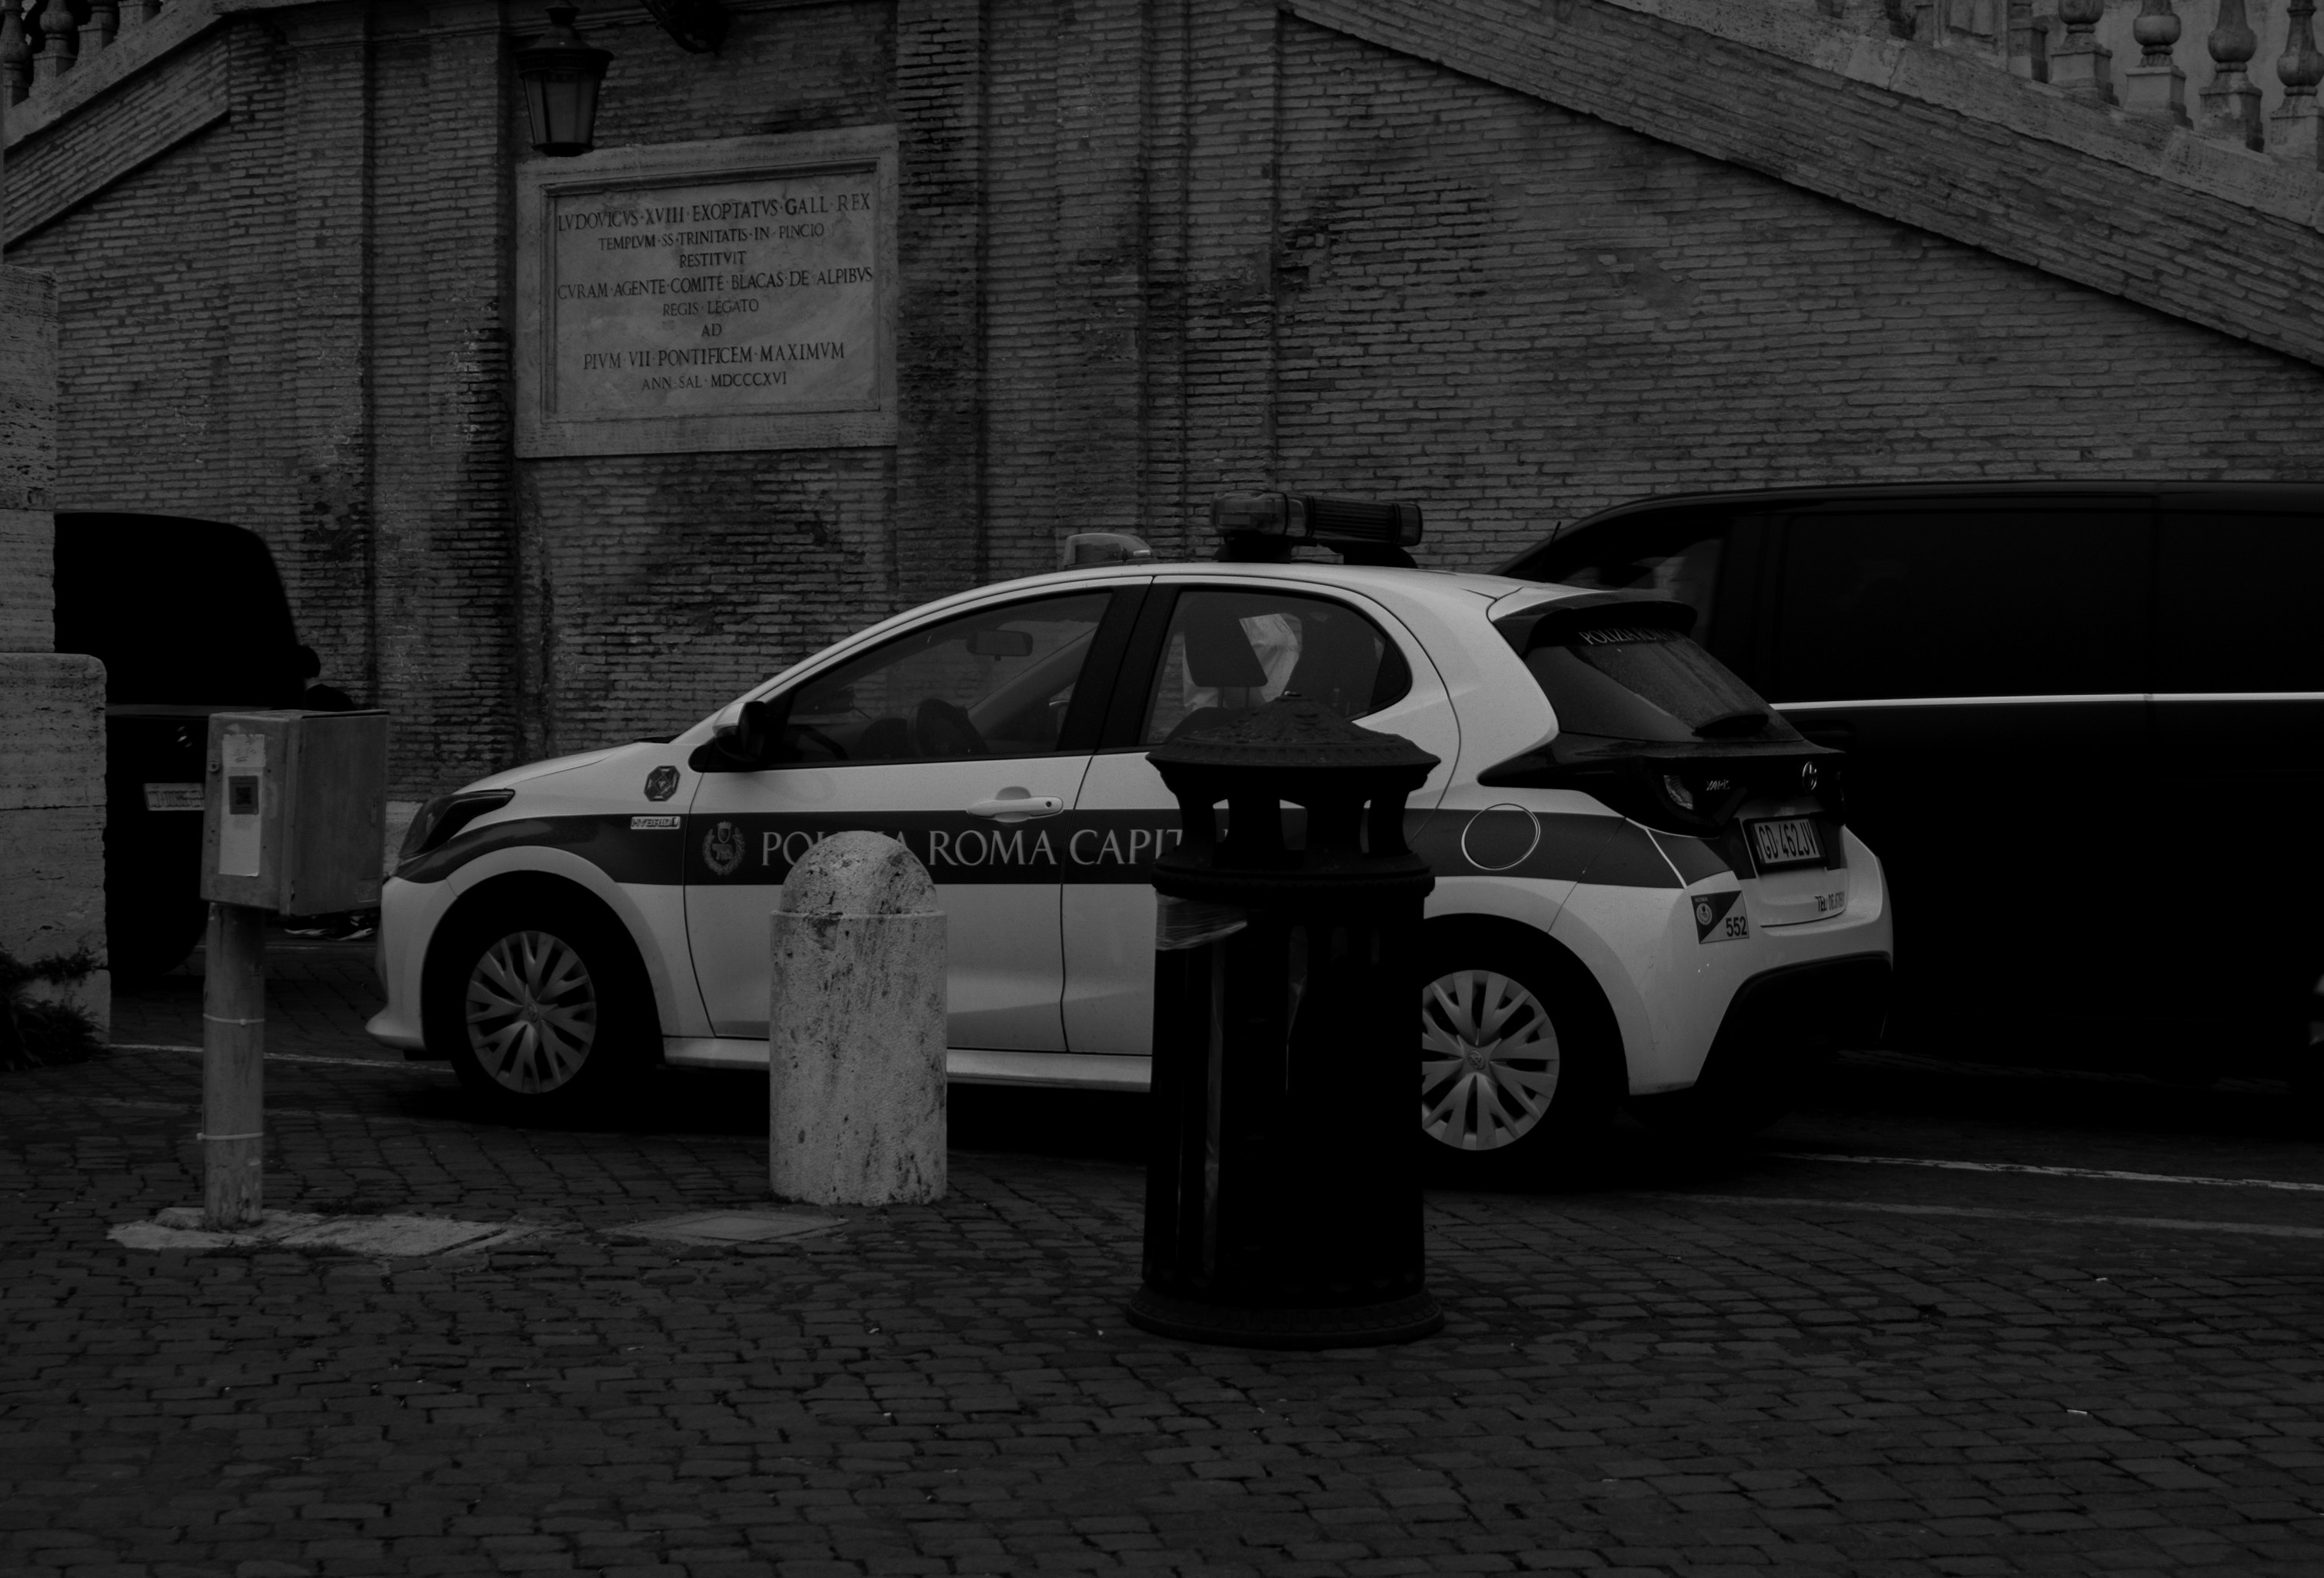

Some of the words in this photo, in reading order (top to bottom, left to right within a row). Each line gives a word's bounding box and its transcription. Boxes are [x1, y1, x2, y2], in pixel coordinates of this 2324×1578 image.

[558, 210, 639, 231] LVDOVICVS
[645, 207, 684, 225] XVIII
[692, 198, 778, 222] EXOPTATVS
[785, 195, 828, 215] GALL
[837, 192, 871, 211] REX
[598, 234, 656, 251] TEMPLVM
[661, 233, 674, 246] SS
[678, 228, 747, 246] TRINITATIS
[754, 226, 770, 241] IN
[778, 222, 825, 240] PINCIO
[678, 250, 747, 268] RESTITVIT
[557, 282, 609, 301] CVRAM
[613, 278, 666, 298] AGENTE
[670, 275, 724, 294] COMITE
[731, 271, 785, 291] BLACAS
[788, 270, 809, 287] DE
[816, 266, 873, 285] ALPIBVS
[662, 301, 699, 317] REGIS
[707, 298, 759, 315] LEGATO
[701, 323, 722, 337] AD
[583, 352, 622, 370] PIVM
[628, 351, 651, 368] VII
[658, 346, 753, 367] PONTIFICEM
[760, 341, 845, 363] MAXIMVM
[641, 376, 672, 391] ANN
[678, 375, 702, 388] SAL
[711, 371, 787, 388] MDCCCXVI
[928, 829, 1058, 866] ROMA
[1070, 828, 1184, 865] CAPIT
[1758, 824, 1779, 859] GD
[1726, 915, 1748, 937] 552
